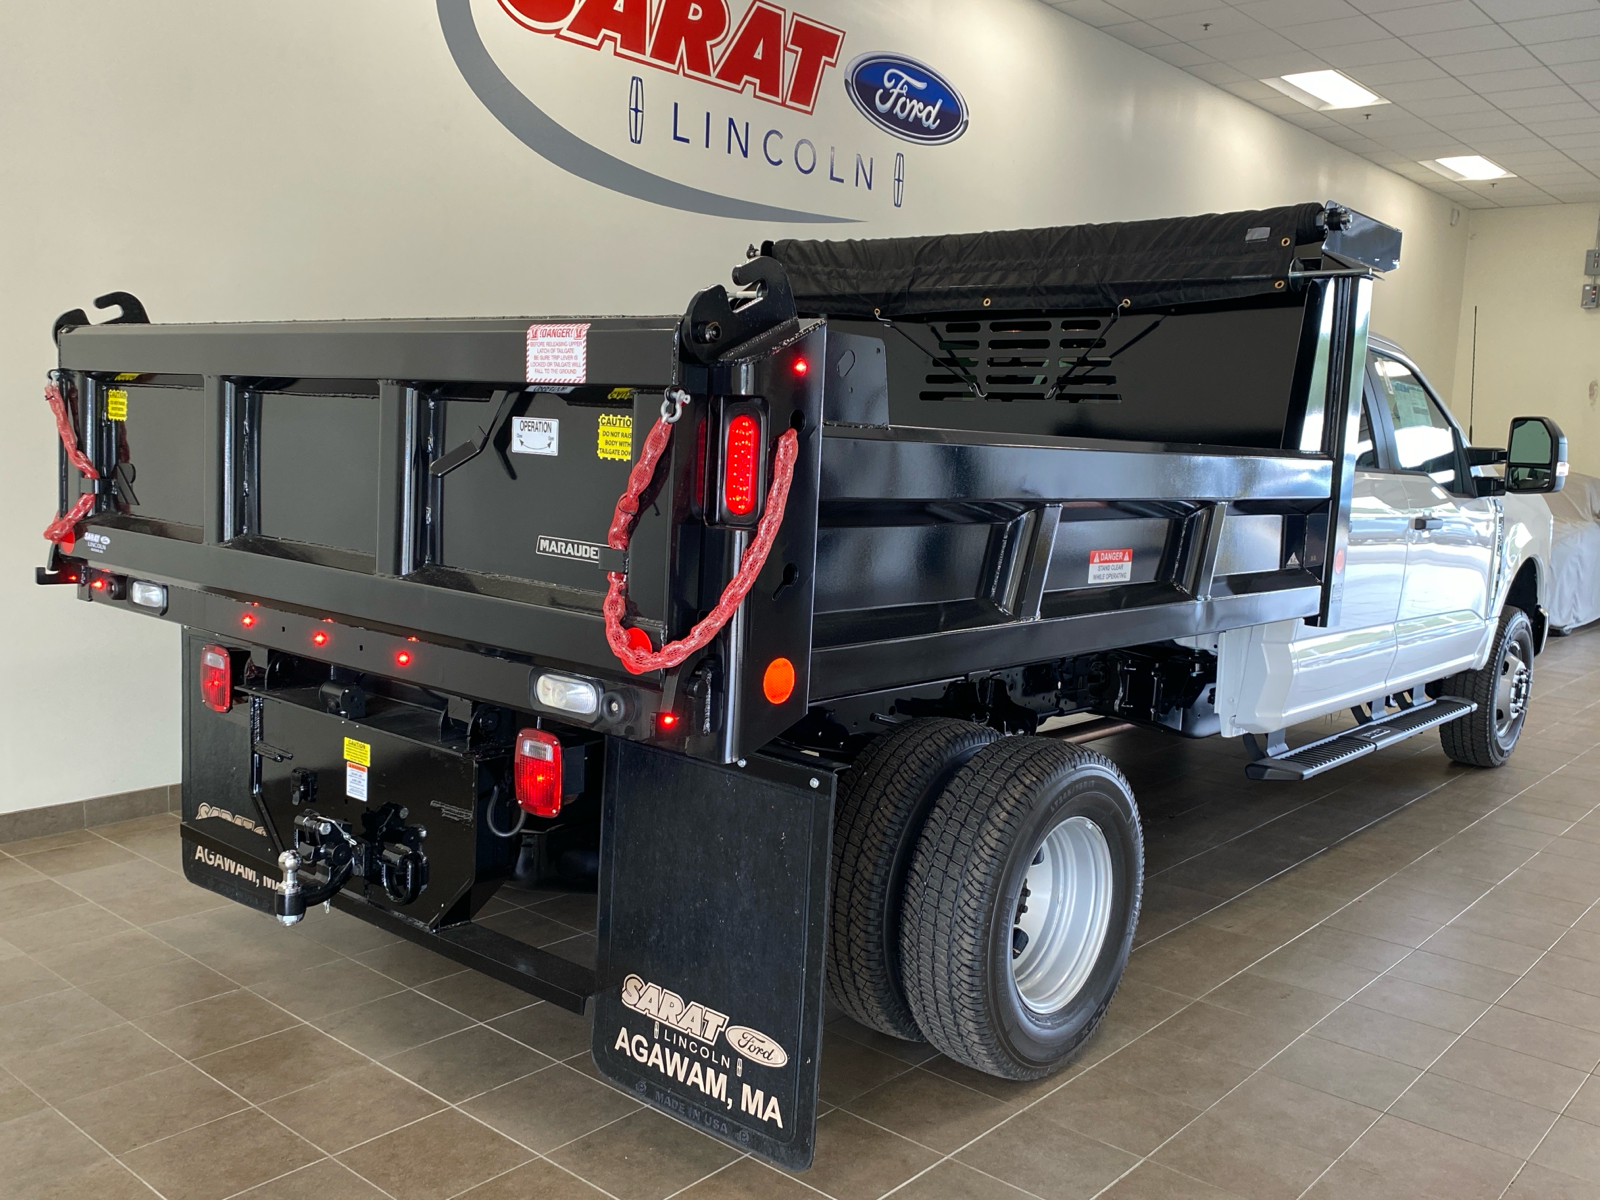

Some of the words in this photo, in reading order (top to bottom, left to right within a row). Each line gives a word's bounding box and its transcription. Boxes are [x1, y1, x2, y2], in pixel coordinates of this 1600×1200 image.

[875, 67, 942, 131] Ford
[672, 101, 874, 191] LINCOLN
[520, 420, 552, 433] OPERATION
[600, 417, 632, 427] CAUTIO
[599, 448, 620, 456] TAILGATE
[540, 539, 599, 559] MARAUDE
[1100, 552, 1124, 562] DANGER
[621, 973, 730, 1046] SARAT
[664, 1029, 731, 1069] LINCOLN
[737, 1031, 774, 1061] Ford
[614, 1027, 733, 1110] AGAWAM,
[740, 1083, 784, 1129] MA
[655, 1090, 685, 1116] MADE
[686, 1107, 700, 1121] IN
[704, 1113, 729, 1135] USA
